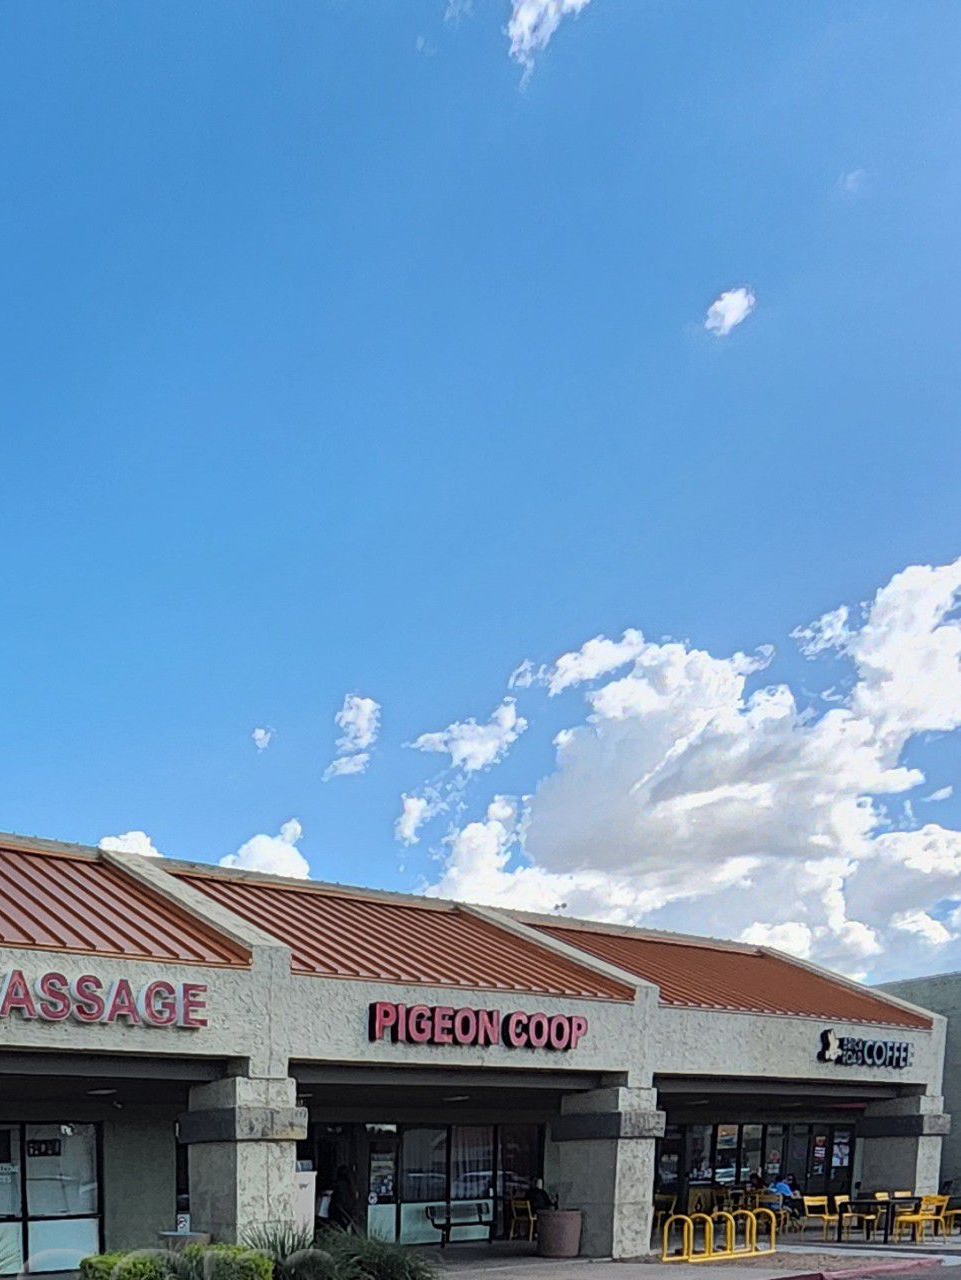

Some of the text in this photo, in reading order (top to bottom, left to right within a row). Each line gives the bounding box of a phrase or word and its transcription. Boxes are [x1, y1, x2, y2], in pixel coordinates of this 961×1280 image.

[369, 1001, 588, 1051] PIGEON COOP
[864, 1040, 915, 1068] COFFEE
